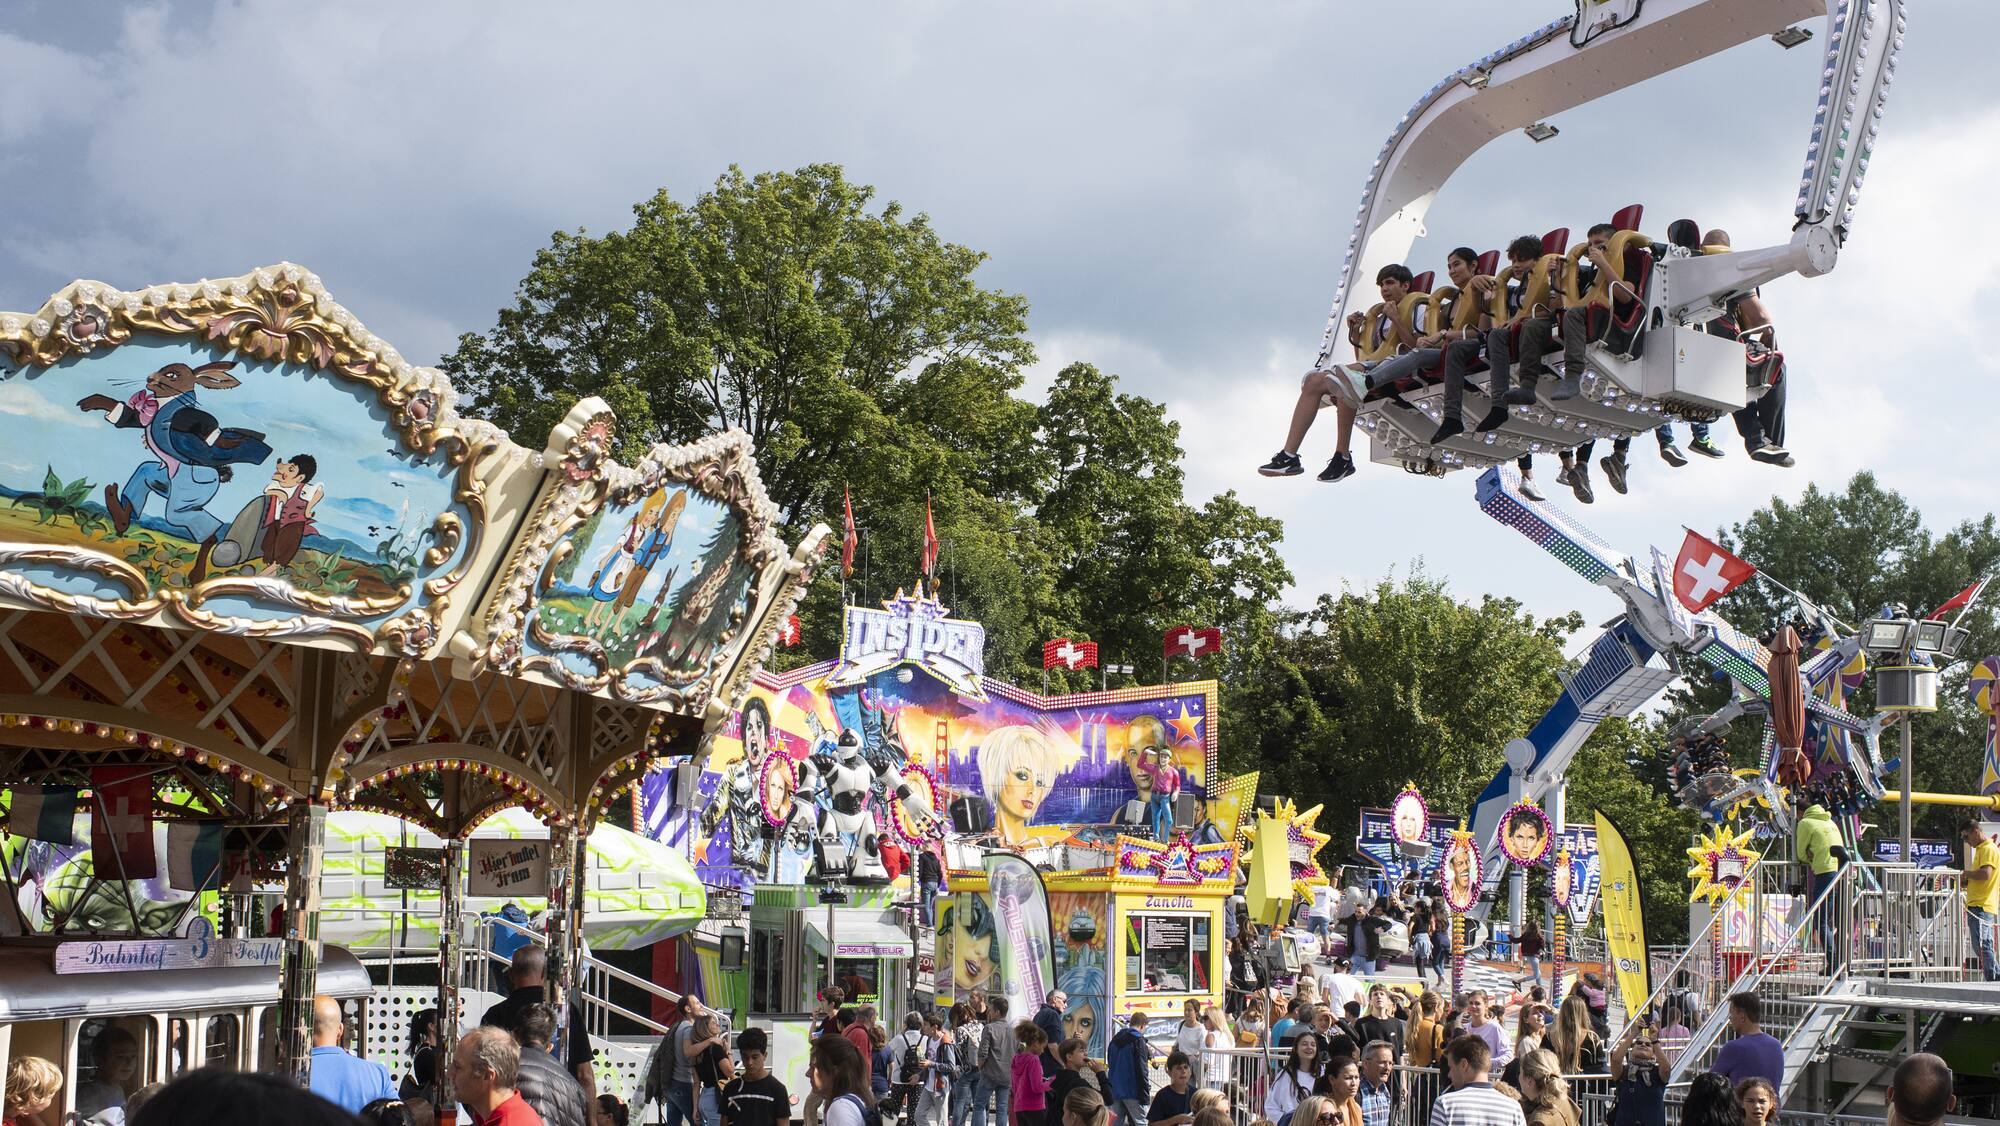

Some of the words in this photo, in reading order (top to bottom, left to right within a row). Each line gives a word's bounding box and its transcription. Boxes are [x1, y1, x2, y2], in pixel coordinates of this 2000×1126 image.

[1368, 821, 1455, 843] PEUS
[1556, 833, 1599, 855] EGAS
[1880, 842, 1948, 855] PEASUS
[85, 942, 168, 970] Bahnhof
[191, 918, 210, 960] 3
[235, 939, 282, 965] Festpl
[837, 944, 905, 956] SIMULATEUR
